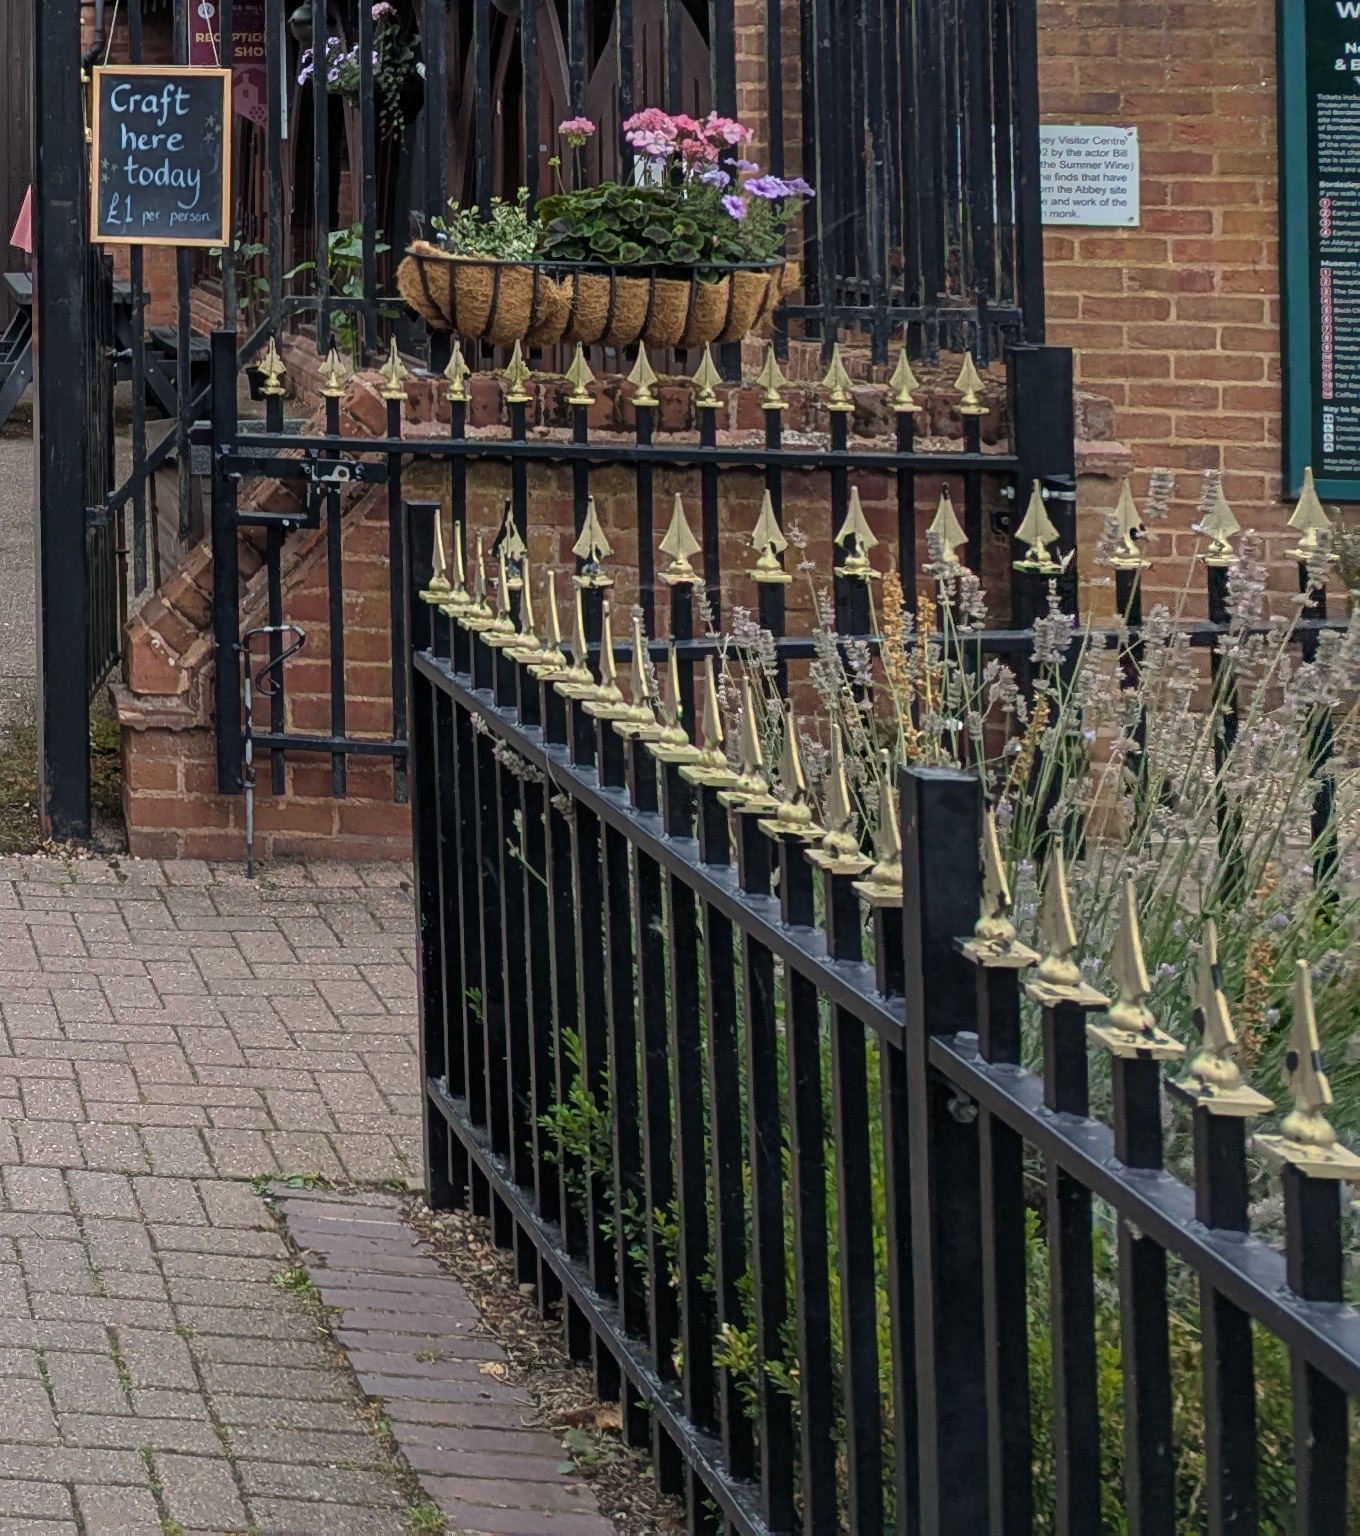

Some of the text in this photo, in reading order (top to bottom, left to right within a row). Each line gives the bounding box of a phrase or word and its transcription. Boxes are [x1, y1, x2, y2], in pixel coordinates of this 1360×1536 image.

[110, 83, 191, 127] Craft
[120, 122, 185, 152] here
[1058, 135, 1090, 145] Visitor
[1051, 148, 1063, 159] by
[1066, 148, 1082, 157] the
[1084, 148, 1111, 157] actor
[1112, 148, 1128, 157] Bill
[1058, 160, 1102, 169] Summer
[1103, 161, 1135, 172] Wine)
[122, 154, 201, 210] today
[1054, 172, 1079, 182] finds
[1081, 173, 1101, 182] that
[1102, 173, 1128, 182] have
[1057, 185, 1073, 194] the
[1074, 185, 1107, 196] Abbey
[1109, 186, 1128, 195] site
[1050, 196, 1071, 206] and
[1072, 197, 1097, 206] work
[1099, 197, 1110, 207] of
[1111, 198, 1128, 207] the
[106, 191, 211, 228] £1 per person
